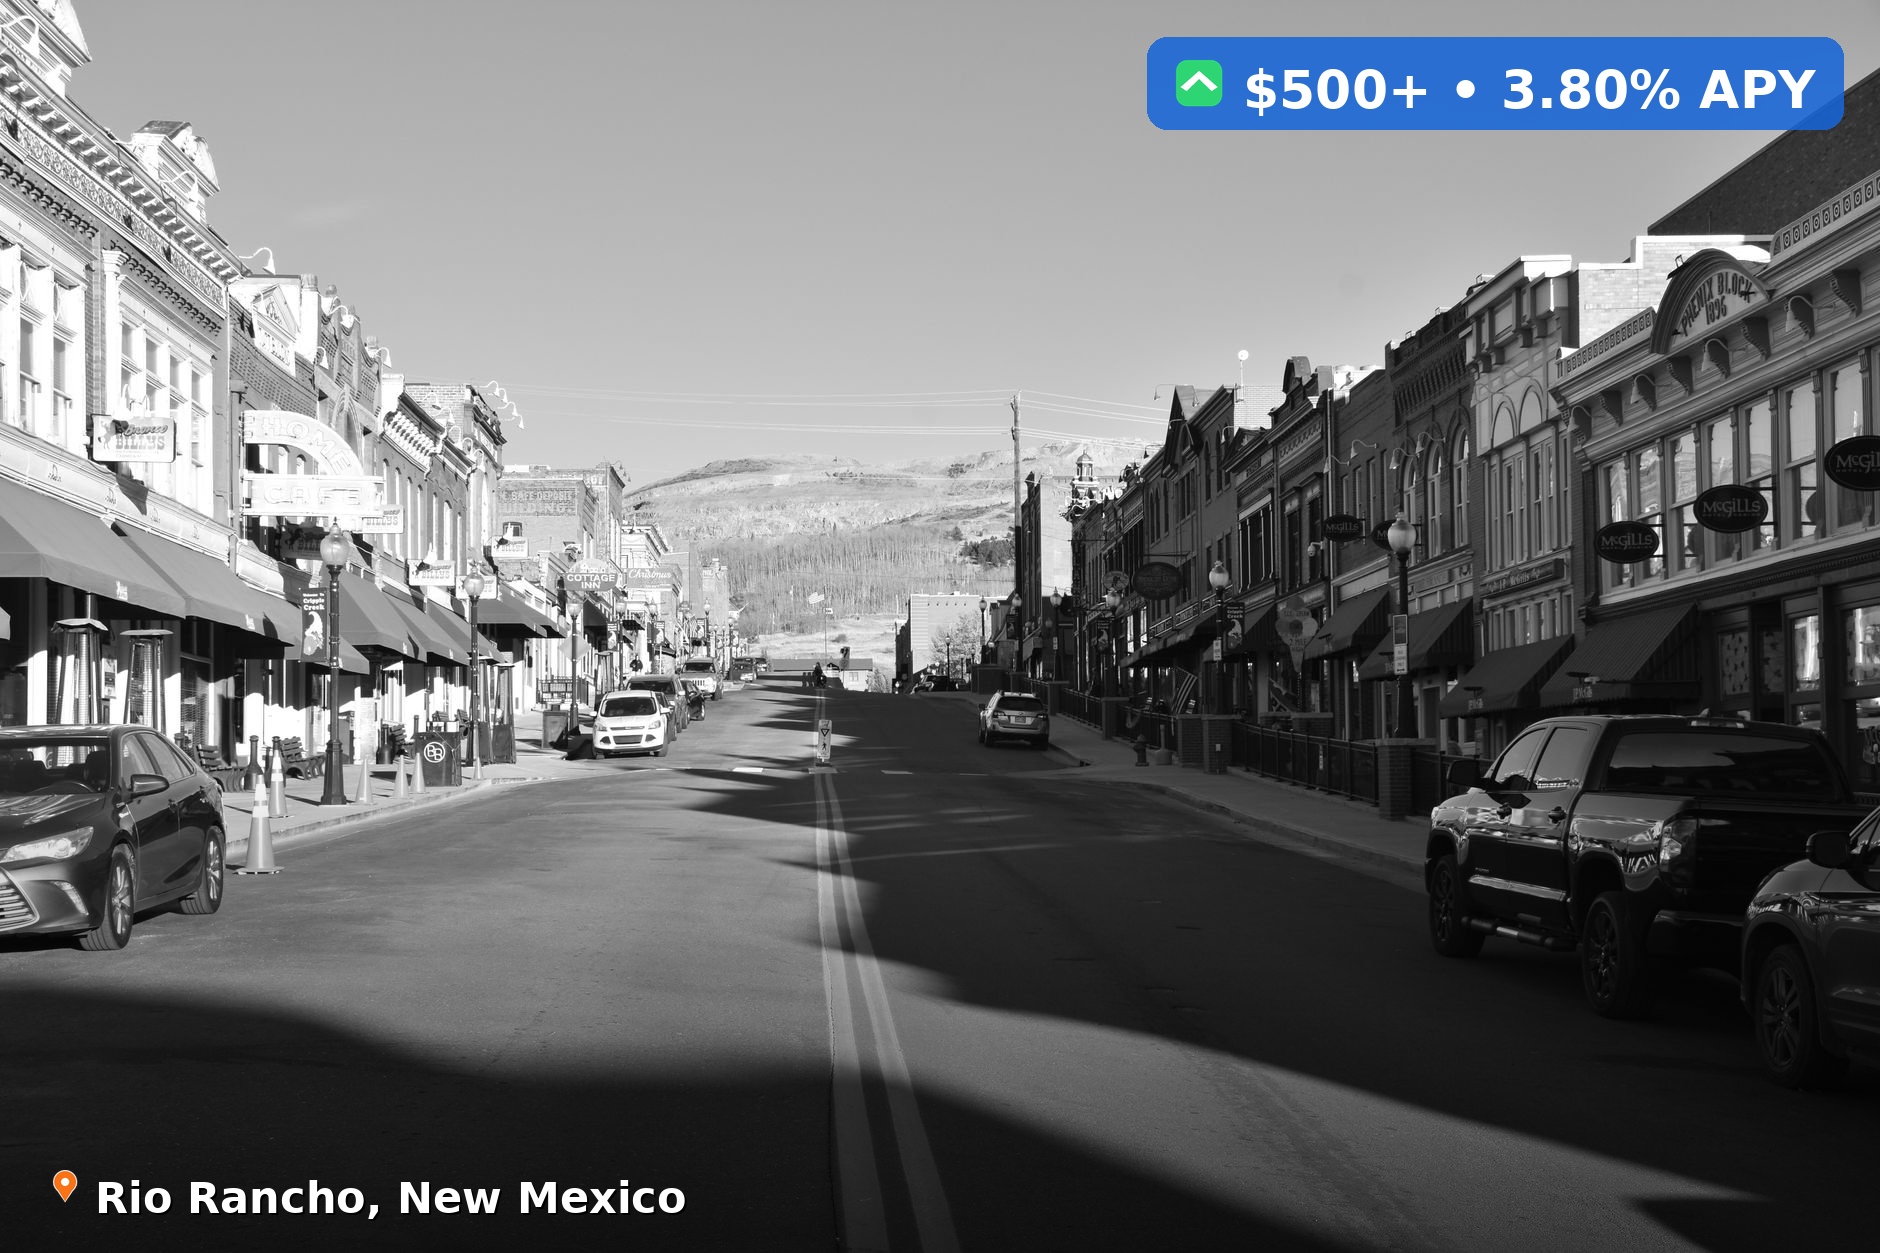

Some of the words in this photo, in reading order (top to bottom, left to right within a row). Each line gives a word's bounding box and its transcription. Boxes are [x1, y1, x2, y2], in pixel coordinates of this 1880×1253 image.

[1681, 277, 1713, 337] PHENIX
[1717, 272, 1752, 303] BLOCK
[1705, 295, 1727, 325] 1896
[123, 424, 168, 437] Bronco
[261, 416, 352, 477] HOME
[1835, 450, 1880, 474] McGil
[263, 486, 361, 505] CAFE
[566, 573, 616, 582] COTTAGE
[581, 581, 601, 589] INN
[303, 597, 325, 605] Cripple
